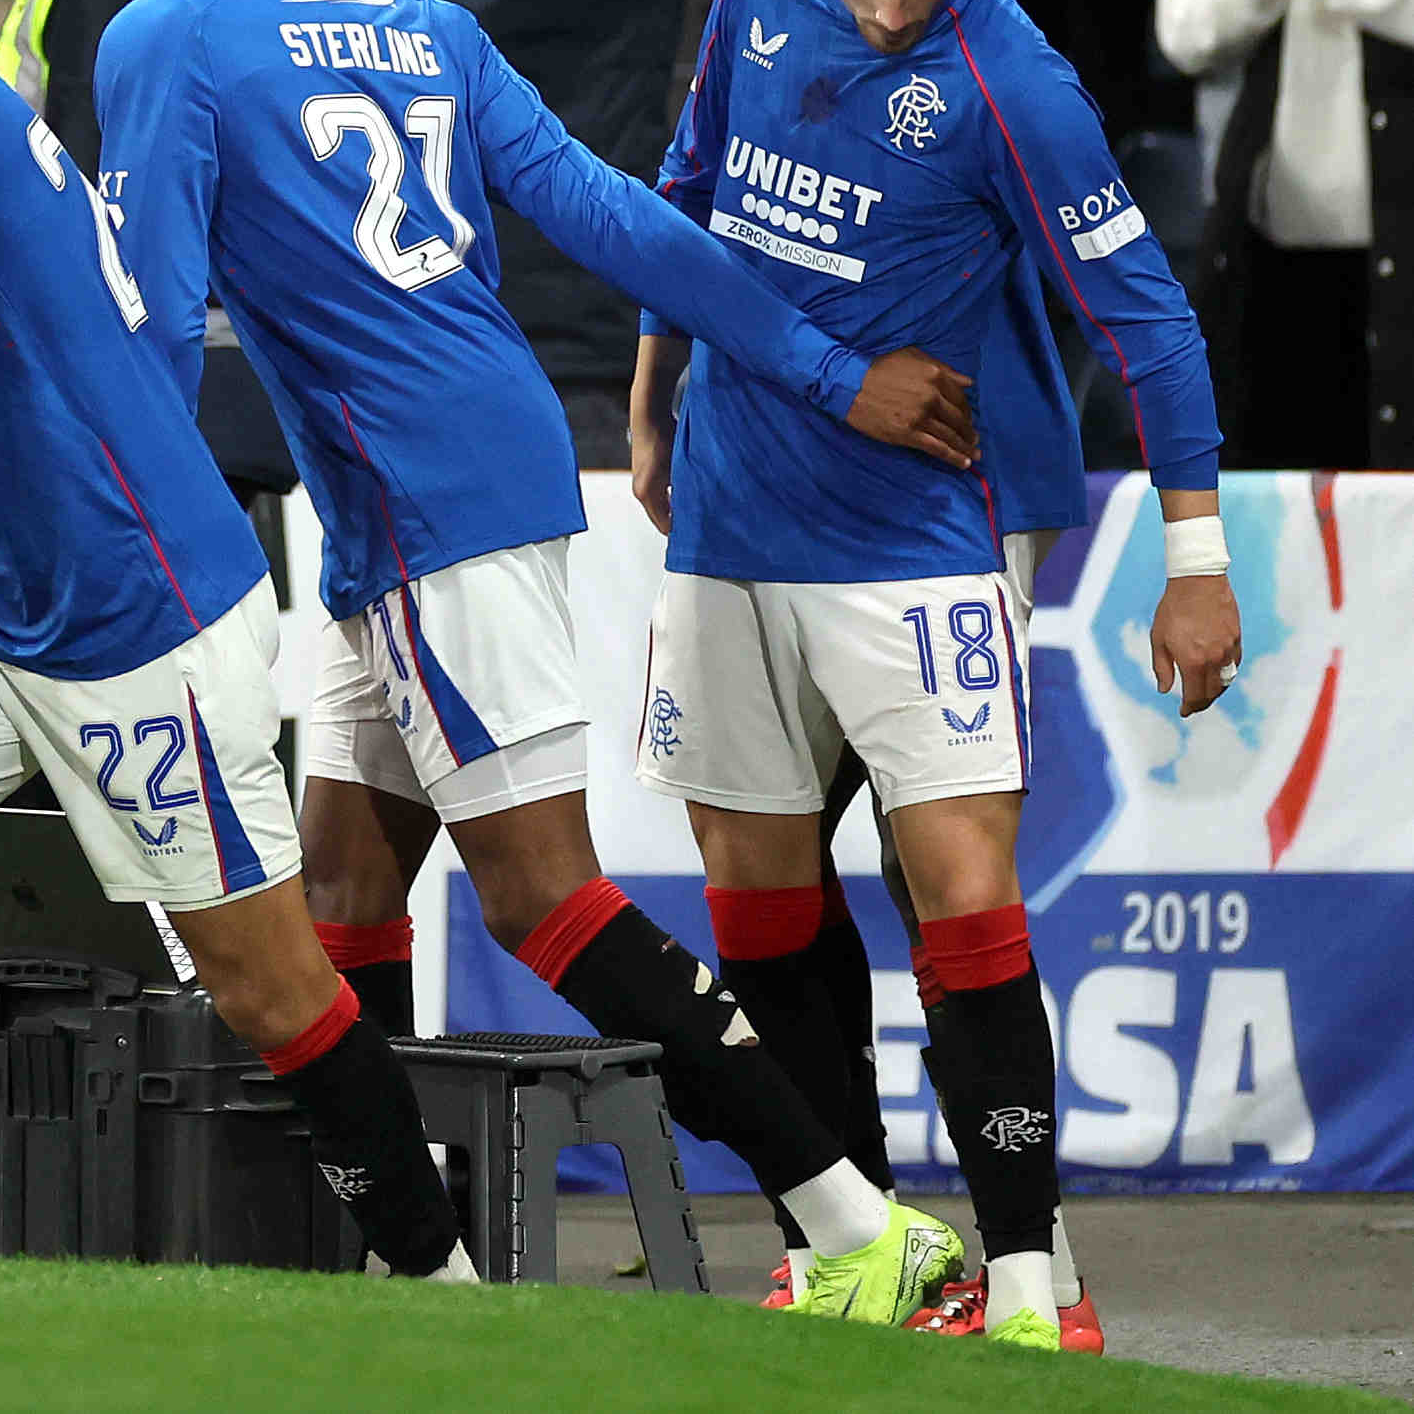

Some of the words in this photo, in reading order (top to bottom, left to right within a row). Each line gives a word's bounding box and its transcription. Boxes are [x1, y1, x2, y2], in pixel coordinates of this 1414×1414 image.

[278, 23, 442, 77] STERLING
[98, 170, 129, 198] XT
[300, 93, 476, 293] 21
[725, 135, 884, 227] UNIBET
[1057, 177, 1135, 231] BOX
[727, 220, 772, 250] ZERO%
[774, 241, 843, 273] MISSION
[902, 601, 1001, 696] 18
[79, 715, 201, 812] 22
[1121, 890, 1250, 955] 2019
